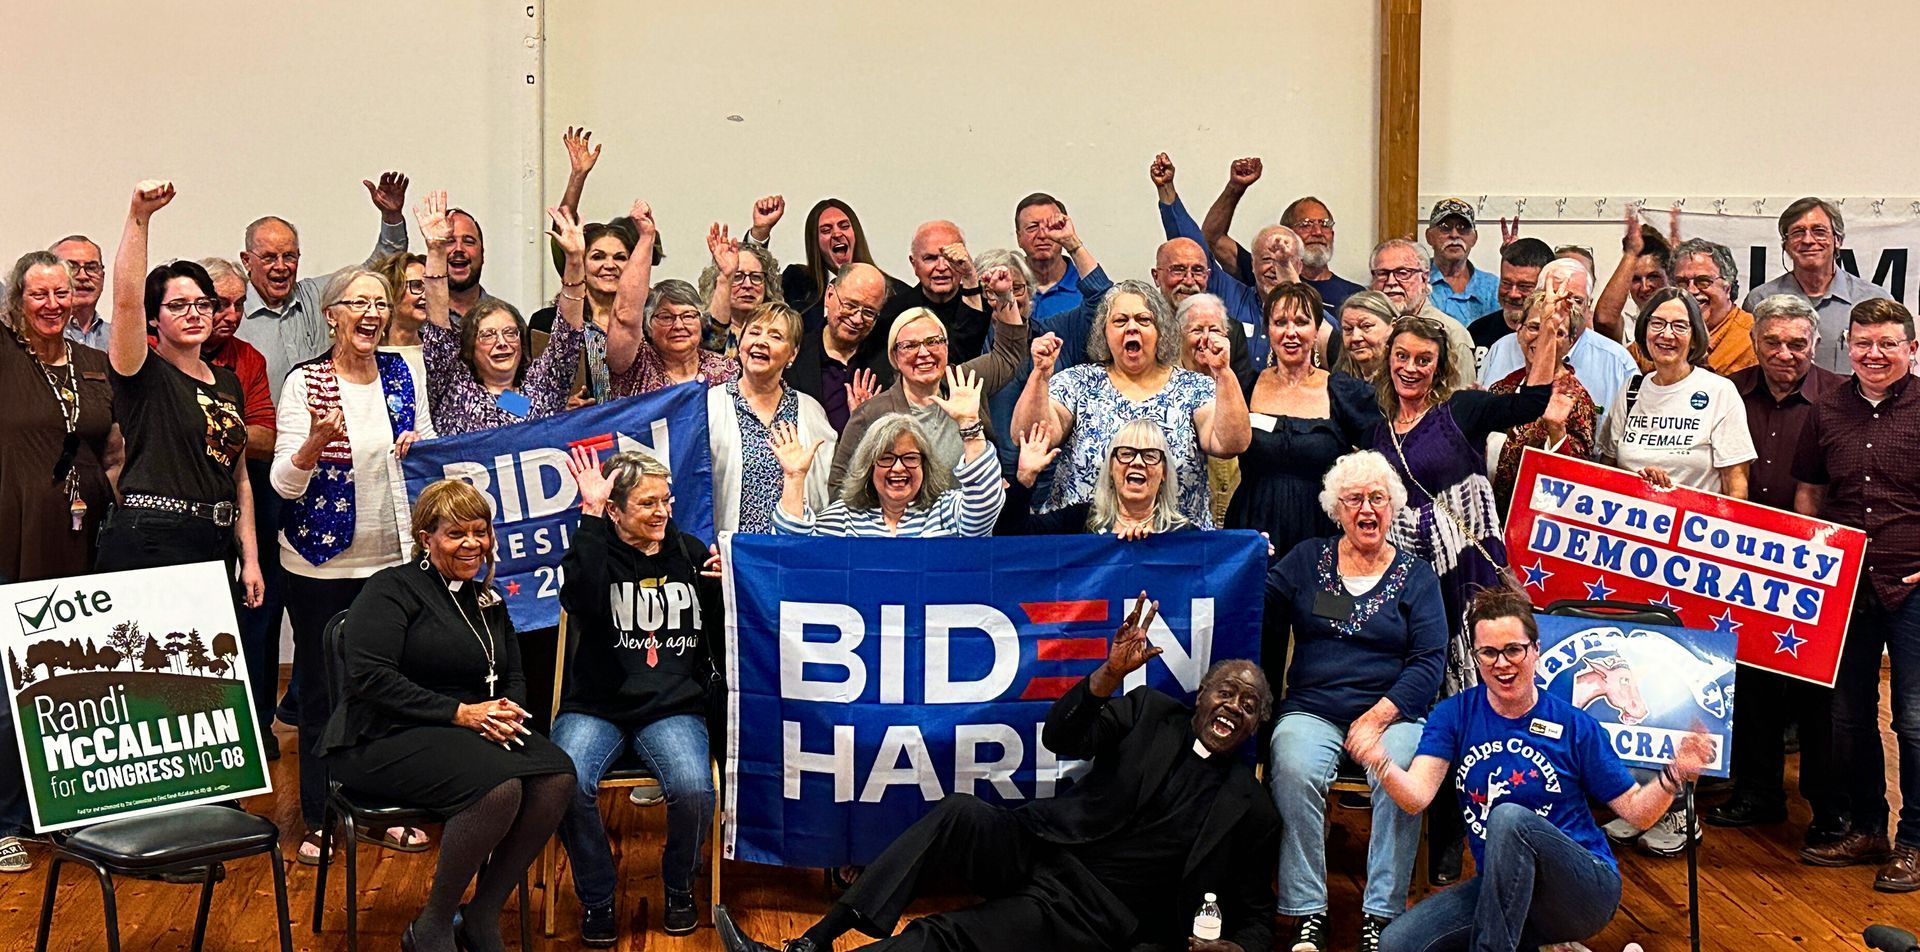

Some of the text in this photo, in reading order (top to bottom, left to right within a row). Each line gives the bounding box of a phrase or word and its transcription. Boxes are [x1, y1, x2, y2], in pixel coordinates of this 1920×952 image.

[1622, 431, 1693, 446] IS FEMALE
[1627, 415, 1701, 430] THE FUTURE
[1540, 478, 1839, 581] Wayne County
[1531, 518, 1821, 620] DEMOCRATS
[614, 631, 699, 656] Never agai
[780, 597, 1215, 705] BIDEN
[34, 684, 130, 735] Randi
[42, 708, 240, 772] McCALLIAN
[1506, 738, 1562, 793] County
[51, 775, 77, 799] for
[82, 755, 185, 793] CONGRESS
[188, 746, 245, 775] MO-08
